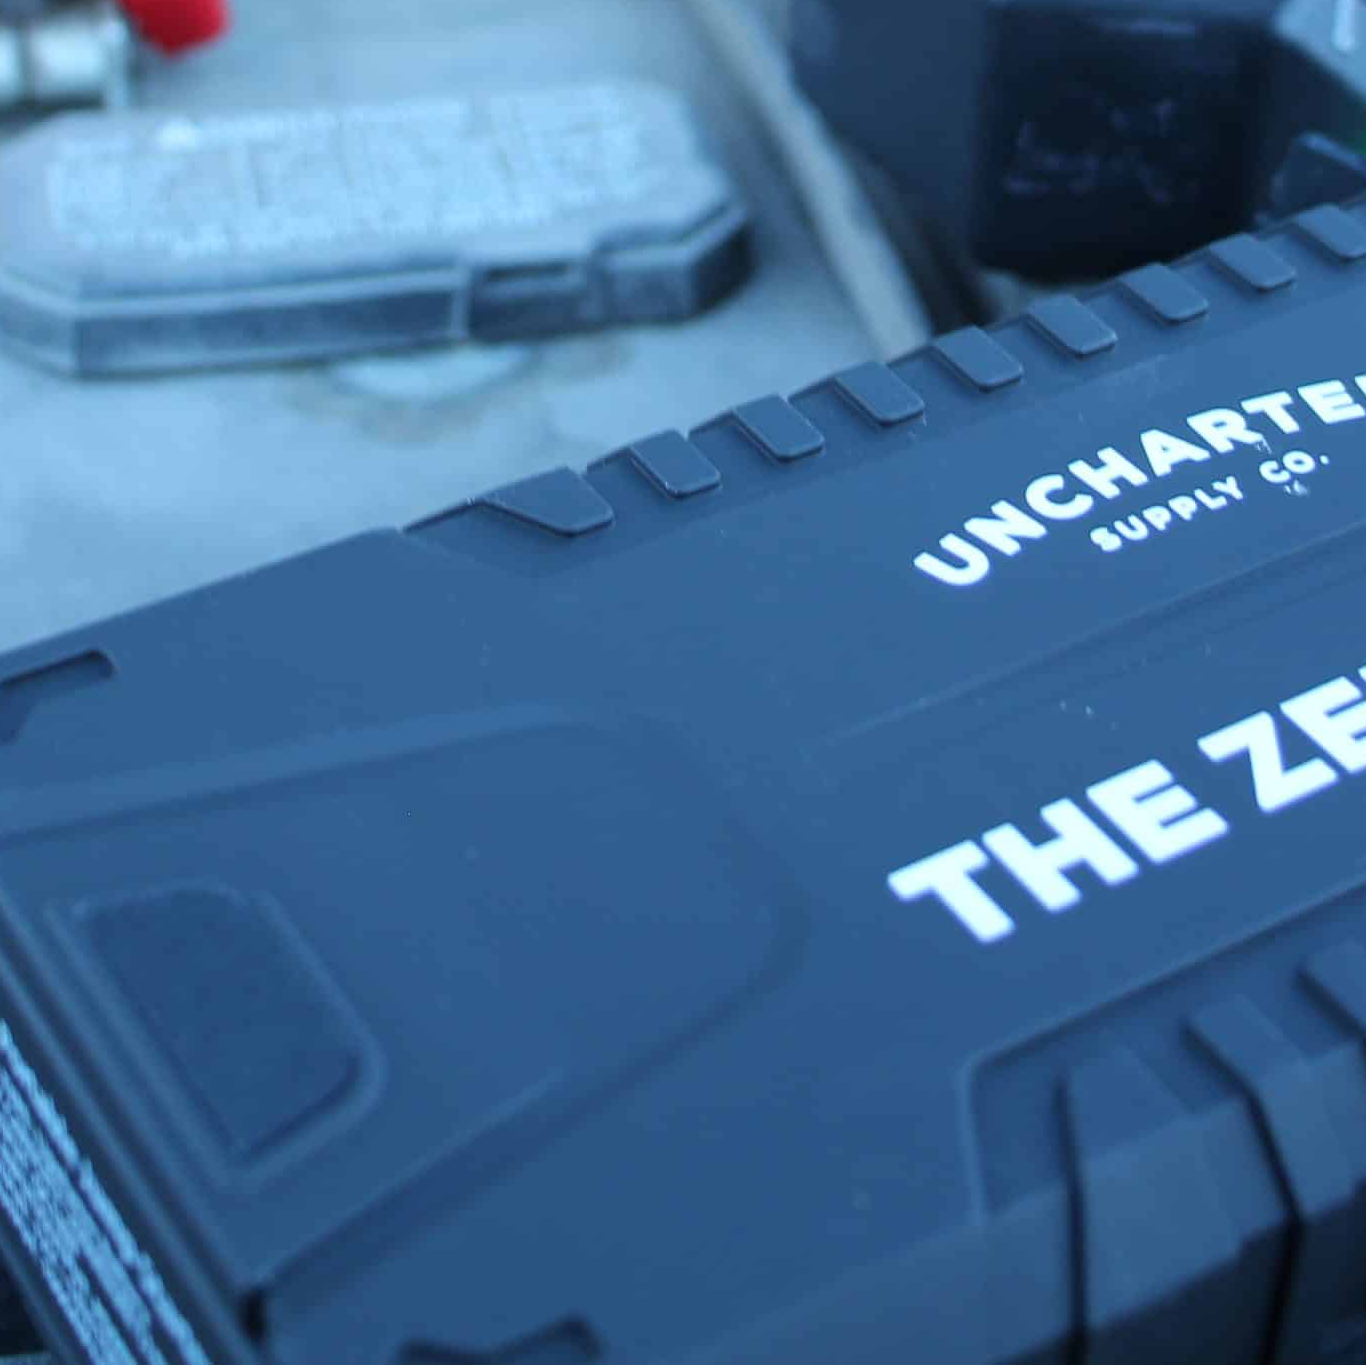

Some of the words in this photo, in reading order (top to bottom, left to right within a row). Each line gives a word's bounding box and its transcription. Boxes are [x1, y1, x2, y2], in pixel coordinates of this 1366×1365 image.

[1090, 476, 1244, 552] SUPPLY
[1259, 451, 1329, 486] CO.
[887, 759, 1228, 943] THE
